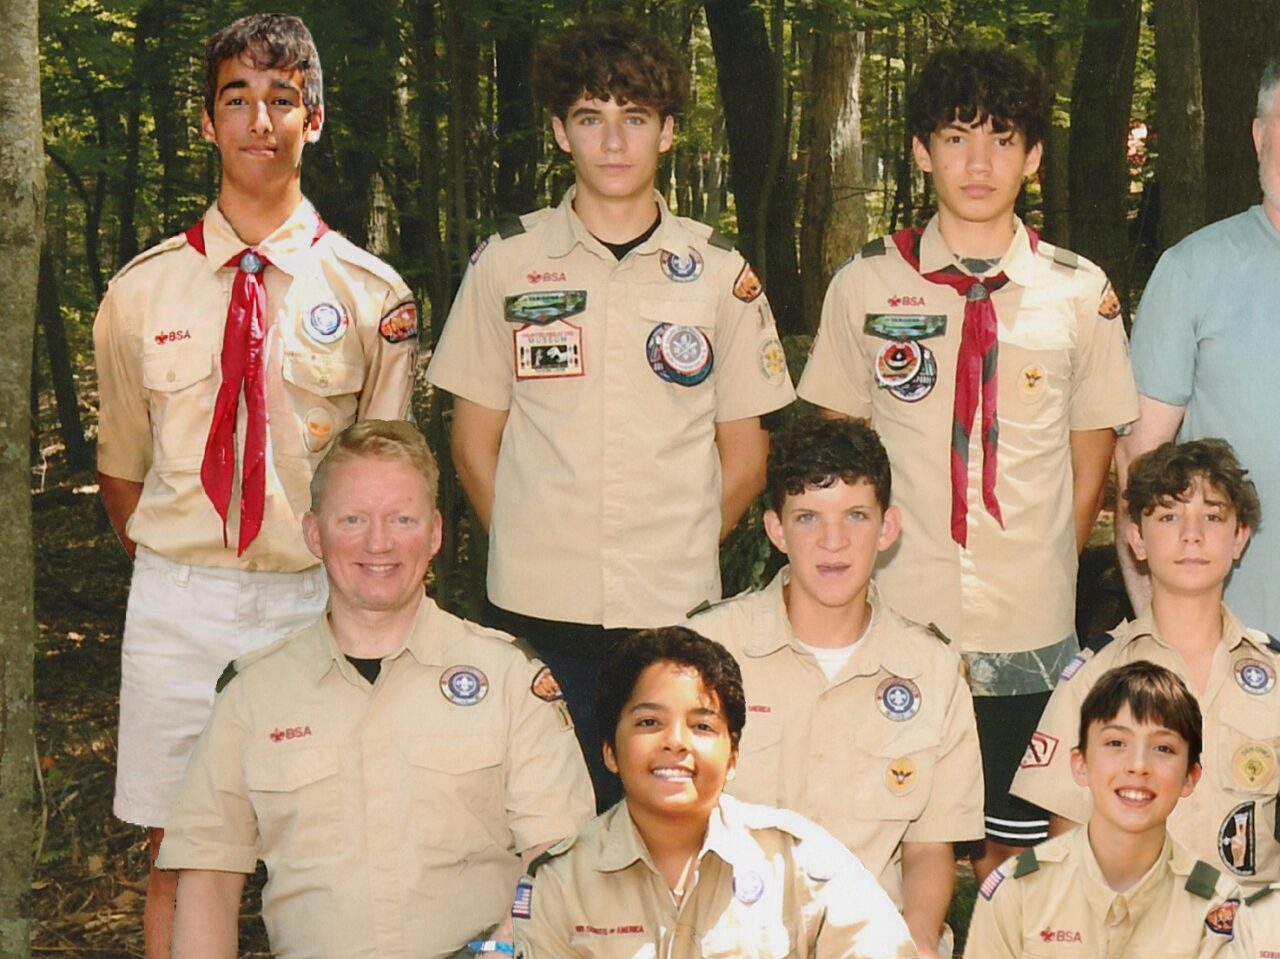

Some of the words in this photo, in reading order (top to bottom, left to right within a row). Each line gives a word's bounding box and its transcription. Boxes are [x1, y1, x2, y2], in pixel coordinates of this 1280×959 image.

[543, 272, 567, 282] BSA
[902, 297, 926, 306] BSA
[168, 330, 191, 341] BSA
[528, 336, 567, 344] MUSEUM
[286, 726, 312, 739] BSA
[1056, 930, 1082, 944] BSA
